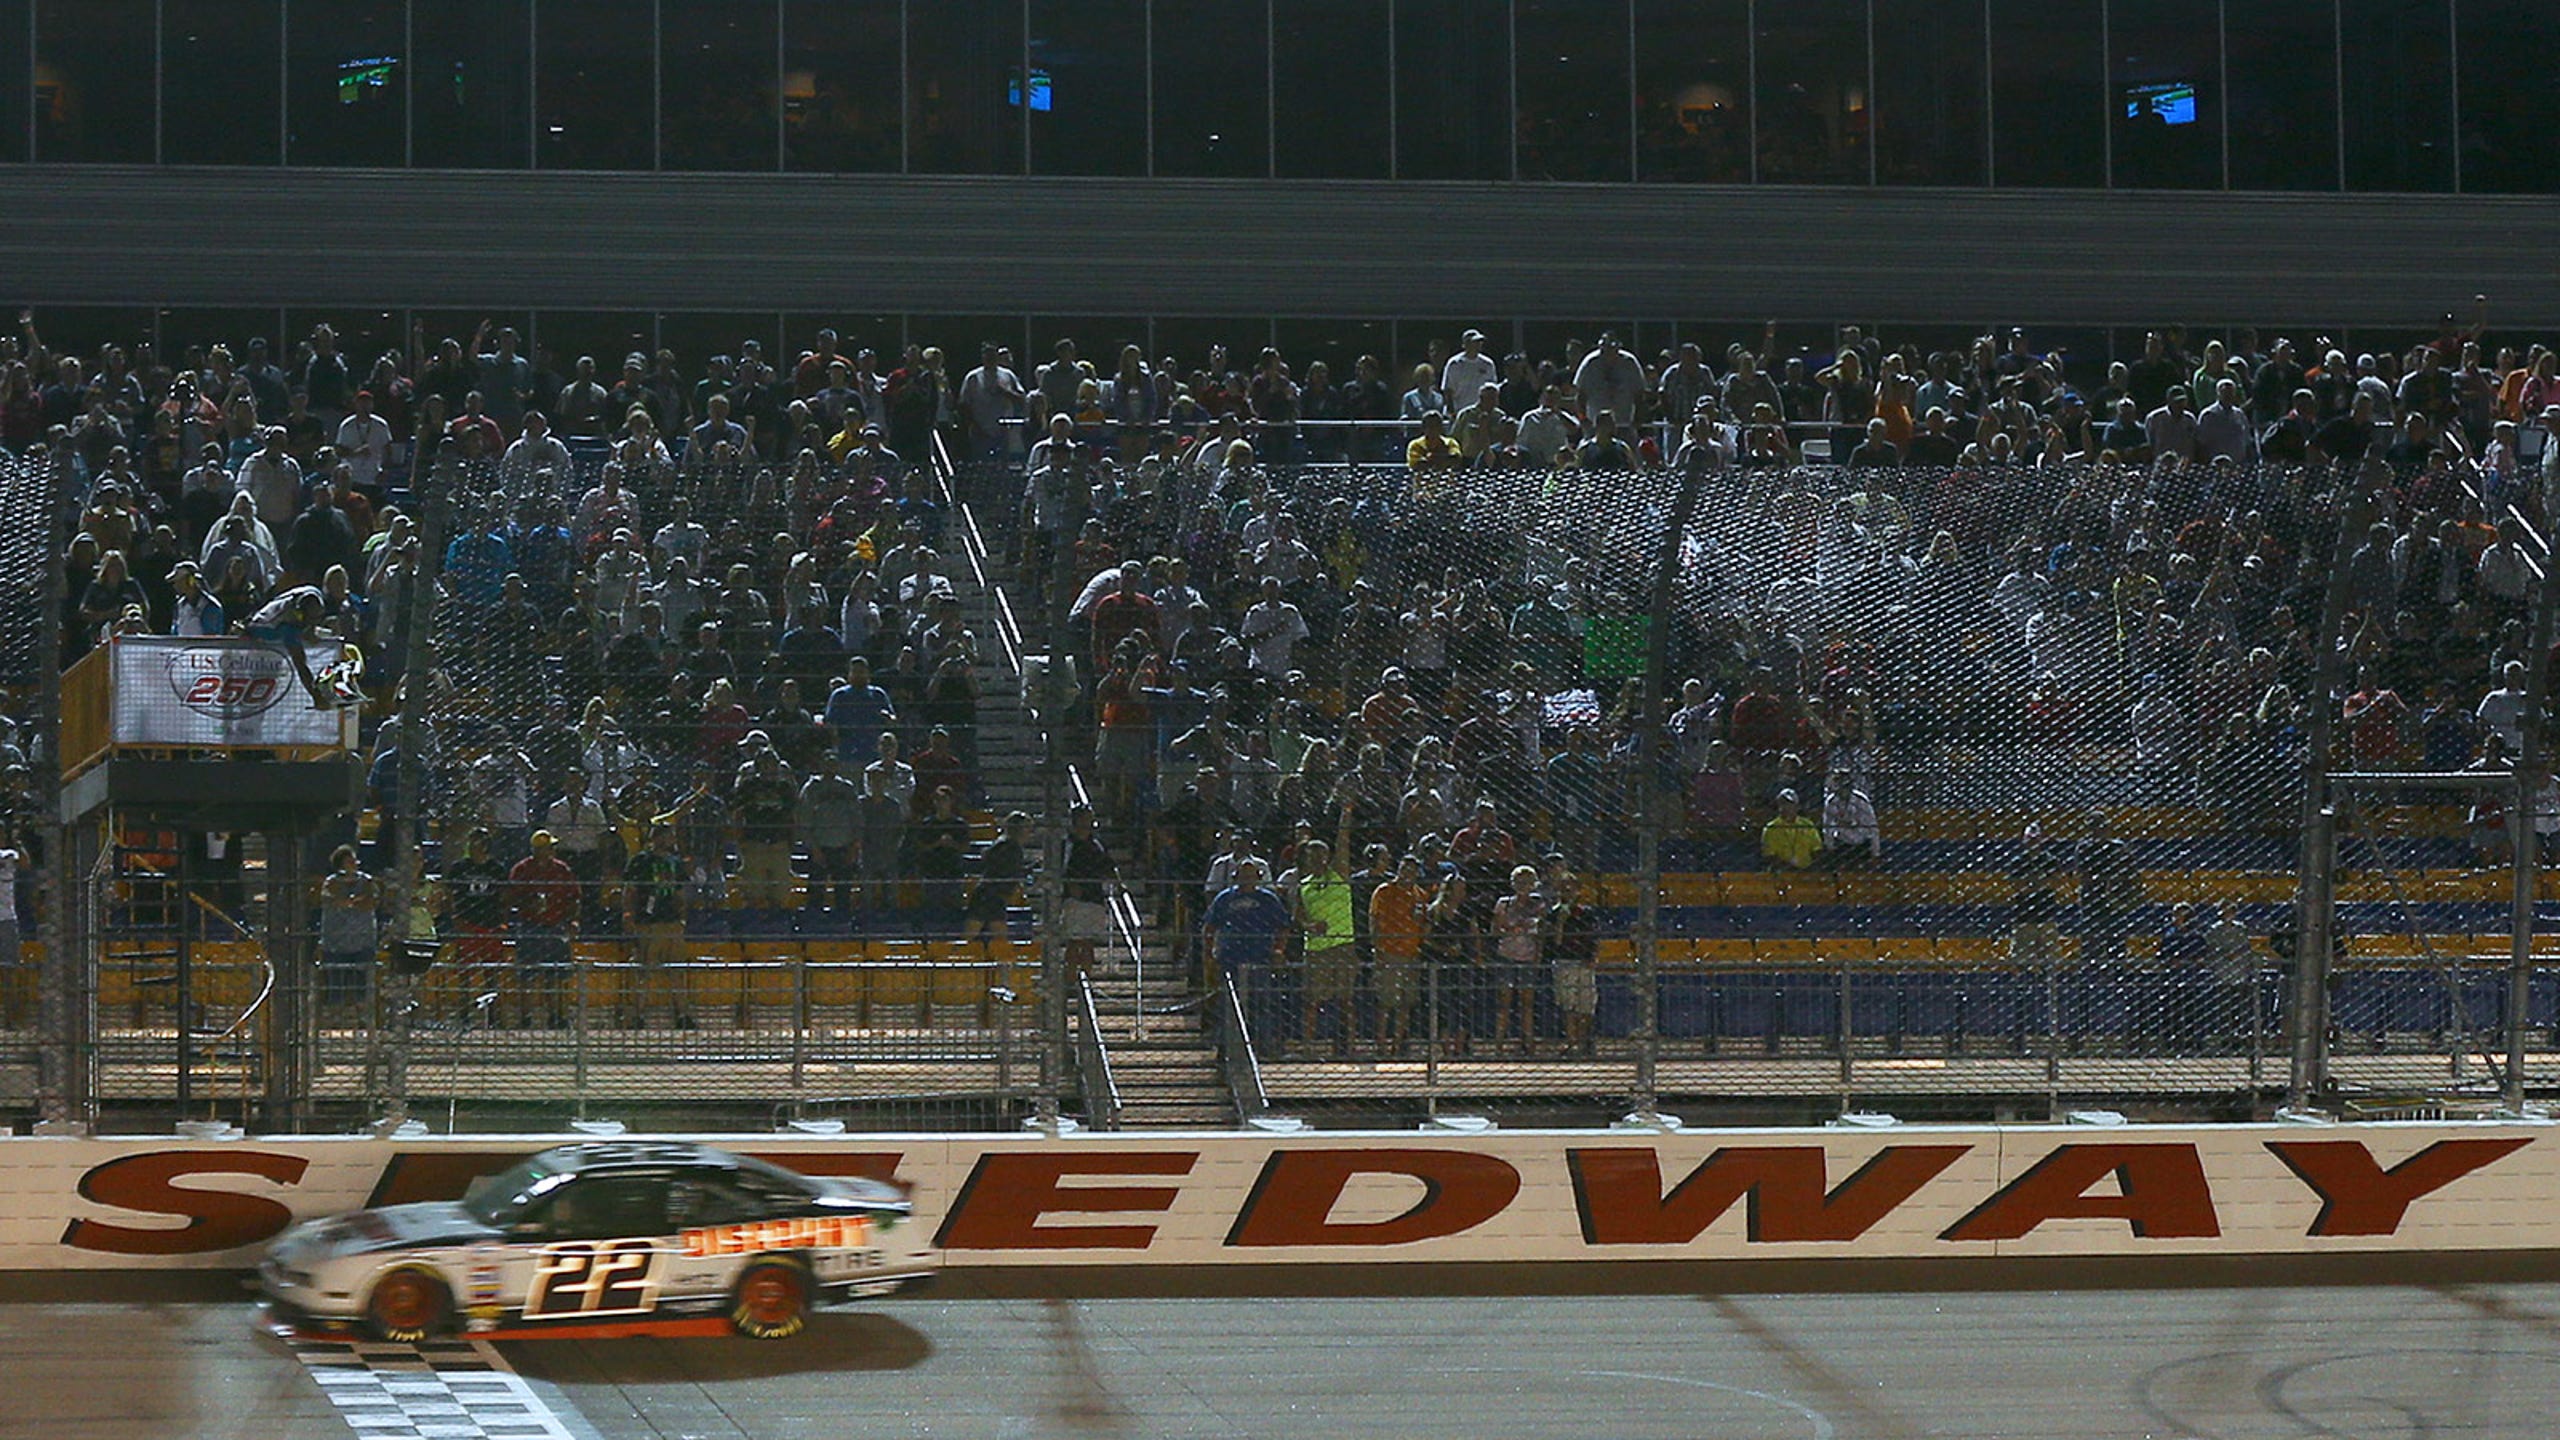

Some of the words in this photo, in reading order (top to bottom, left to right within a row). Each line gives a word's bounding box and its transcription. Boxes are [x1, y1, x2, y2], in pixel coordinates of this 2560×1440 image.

[183, 674, 277, 706] 250
[61, 1138, 2535, 1255] SEDWAY
[524, 1241, 662, 1318] 22
